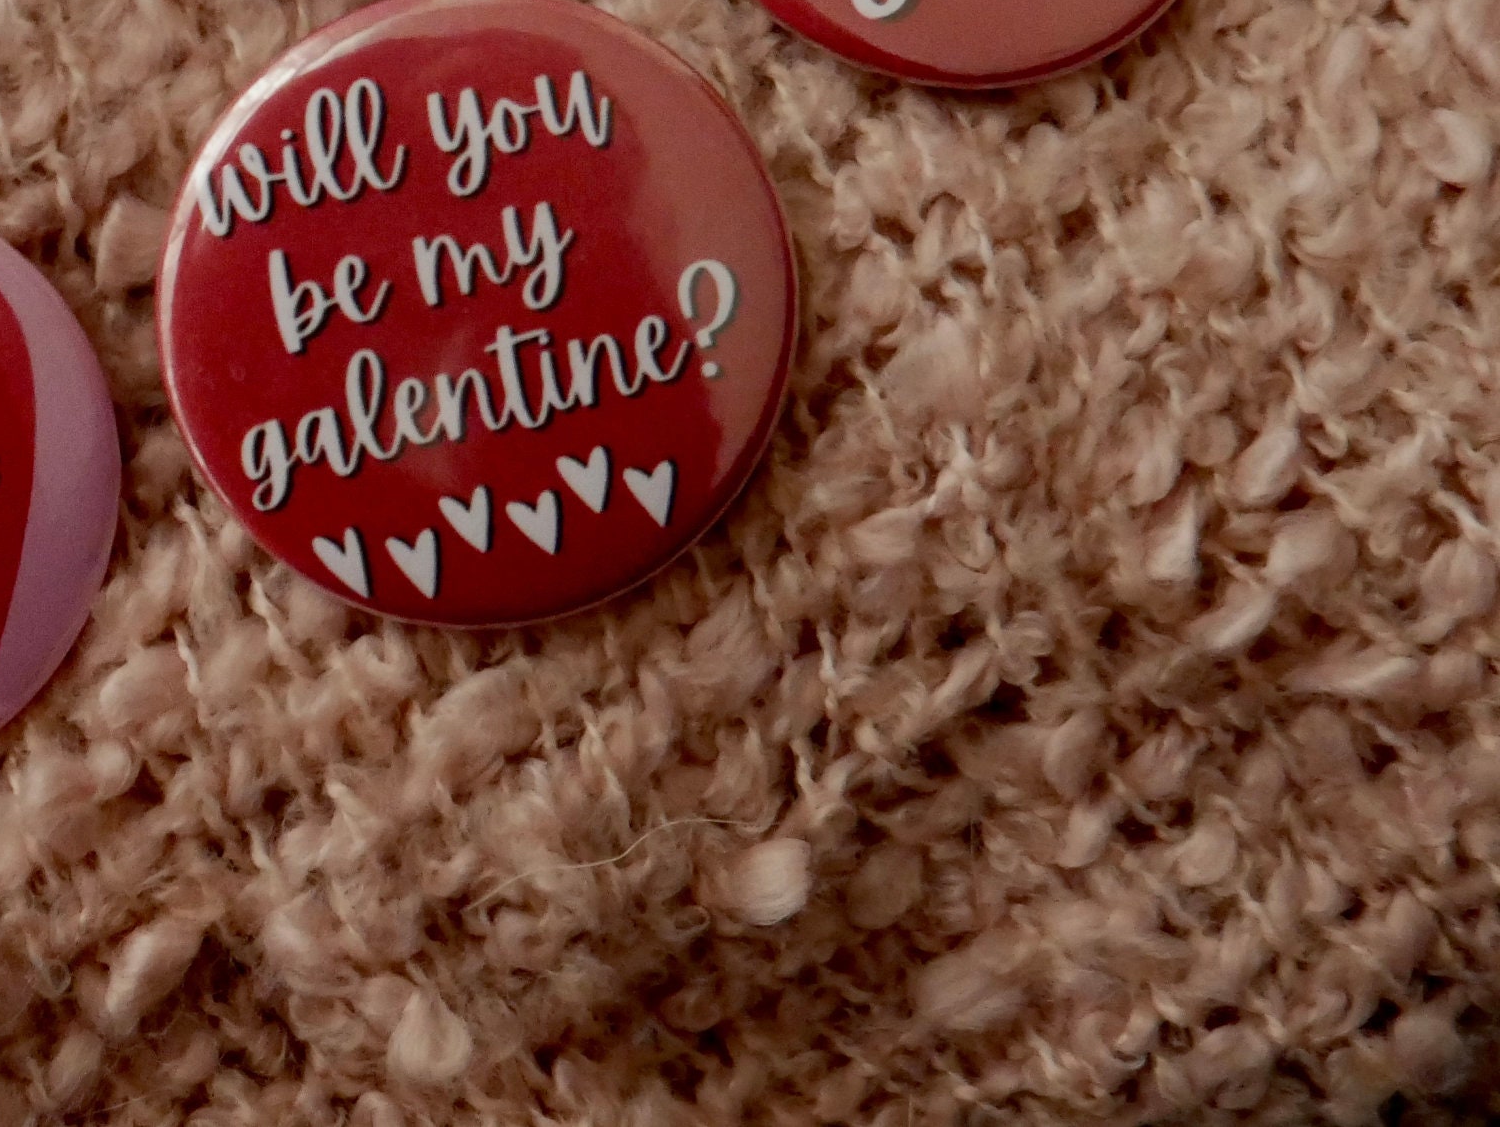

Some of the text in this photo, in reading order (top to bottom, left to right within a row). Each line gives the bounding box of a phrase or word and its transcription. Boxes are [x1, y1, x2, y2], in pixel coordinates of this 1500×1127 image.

[198, 70, 612, 238] will you
[268, 201, 576, 355] be my
[240, 258, 738, 512] galentine?
